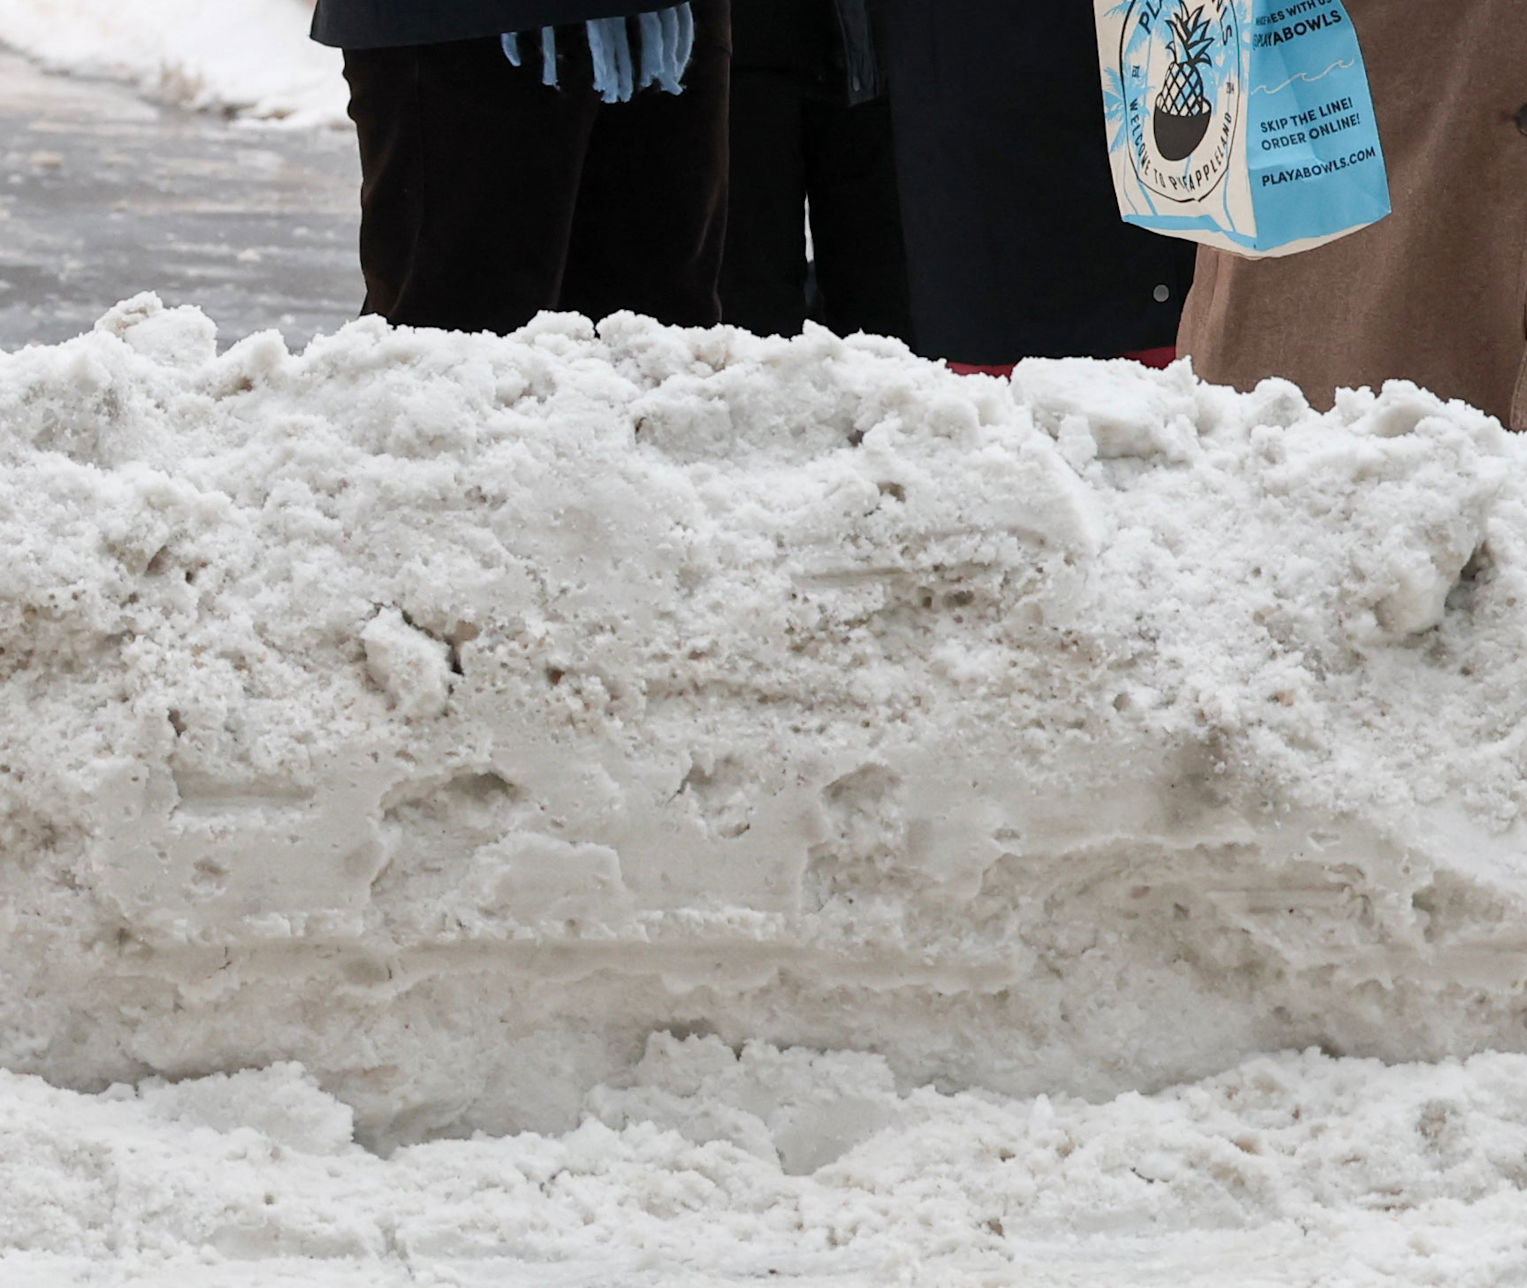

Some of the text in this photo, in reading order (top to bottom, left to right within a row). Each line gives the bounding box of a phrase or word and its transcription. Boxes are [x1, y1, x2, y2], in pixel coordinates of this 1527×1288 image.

[1286, 0, 1316, 16] WITH
[1260, 97, 1353, 133] SKIP THE LINE!
[1261, 113, 1361, 151] ORDER ONLINE!
[1129, 98, 1151, 175] WELCOME
[1153, 168, 1166, 188] TO
[1262, 146, 1376, 187] PLAYABOWLS.COM
